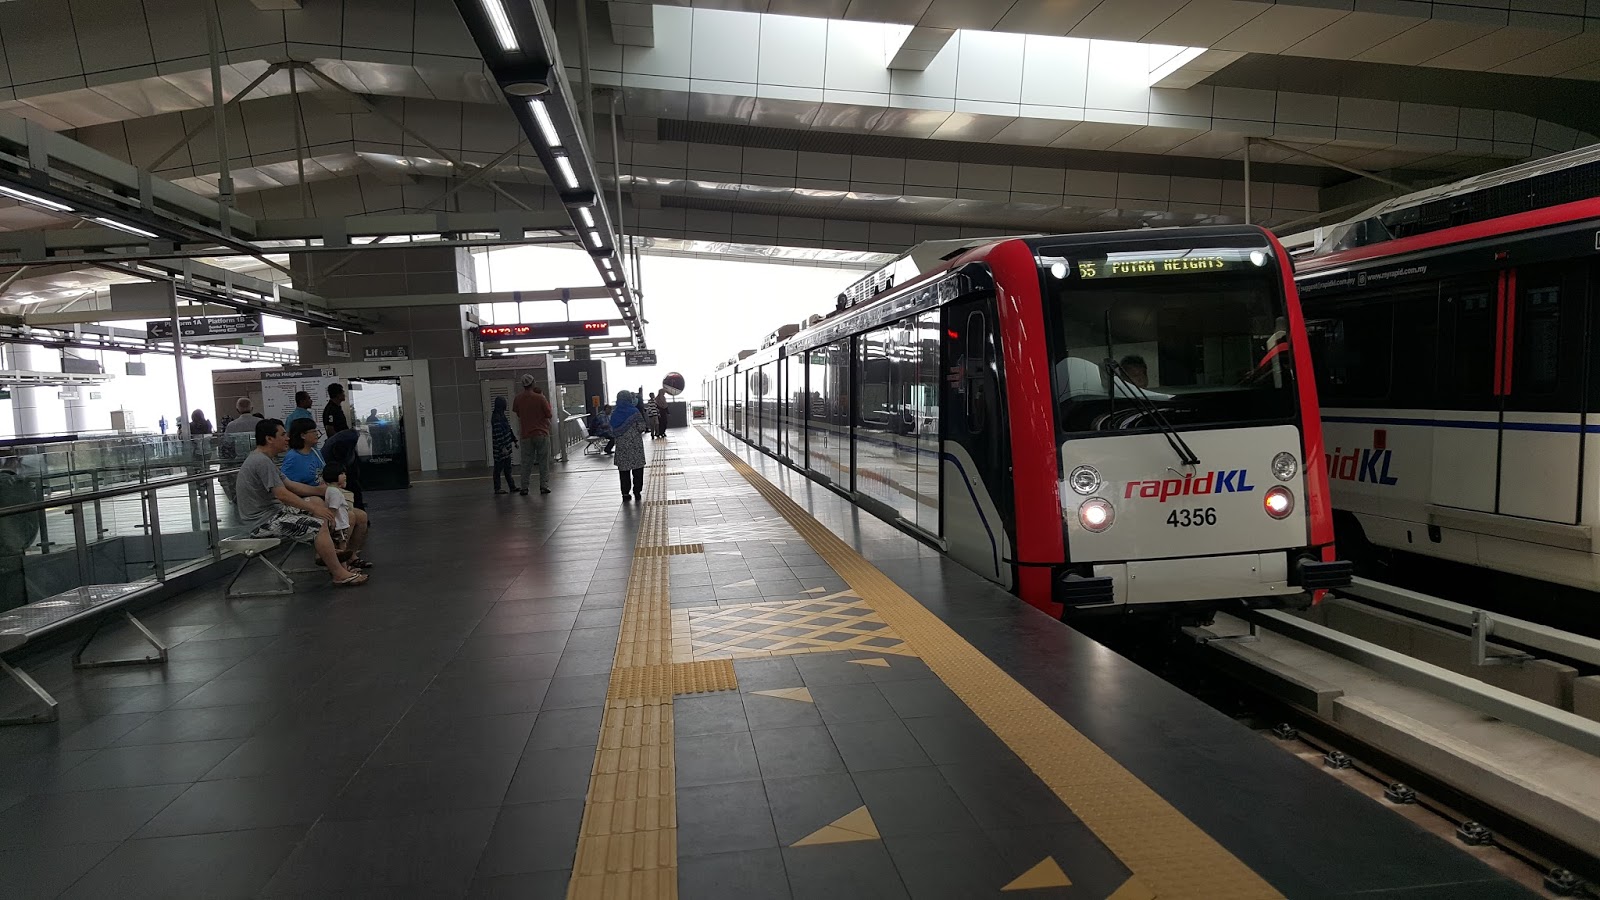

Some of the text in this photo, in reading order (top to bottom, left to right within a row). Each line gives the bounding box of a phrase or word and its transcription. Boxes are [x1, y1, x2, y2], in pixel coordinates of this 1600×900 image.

[1112, 261, 1155, 274] PUTRA
[1164, 256, 1224, 271] HEIGHTS
[1367, 265, 1428, 281] www.myrapid.com.my
[365, 349, 378, 357] Lif
[1124, 469, 1255, 502] rapidKL
[1166, 507, 1217, 528] 4356
